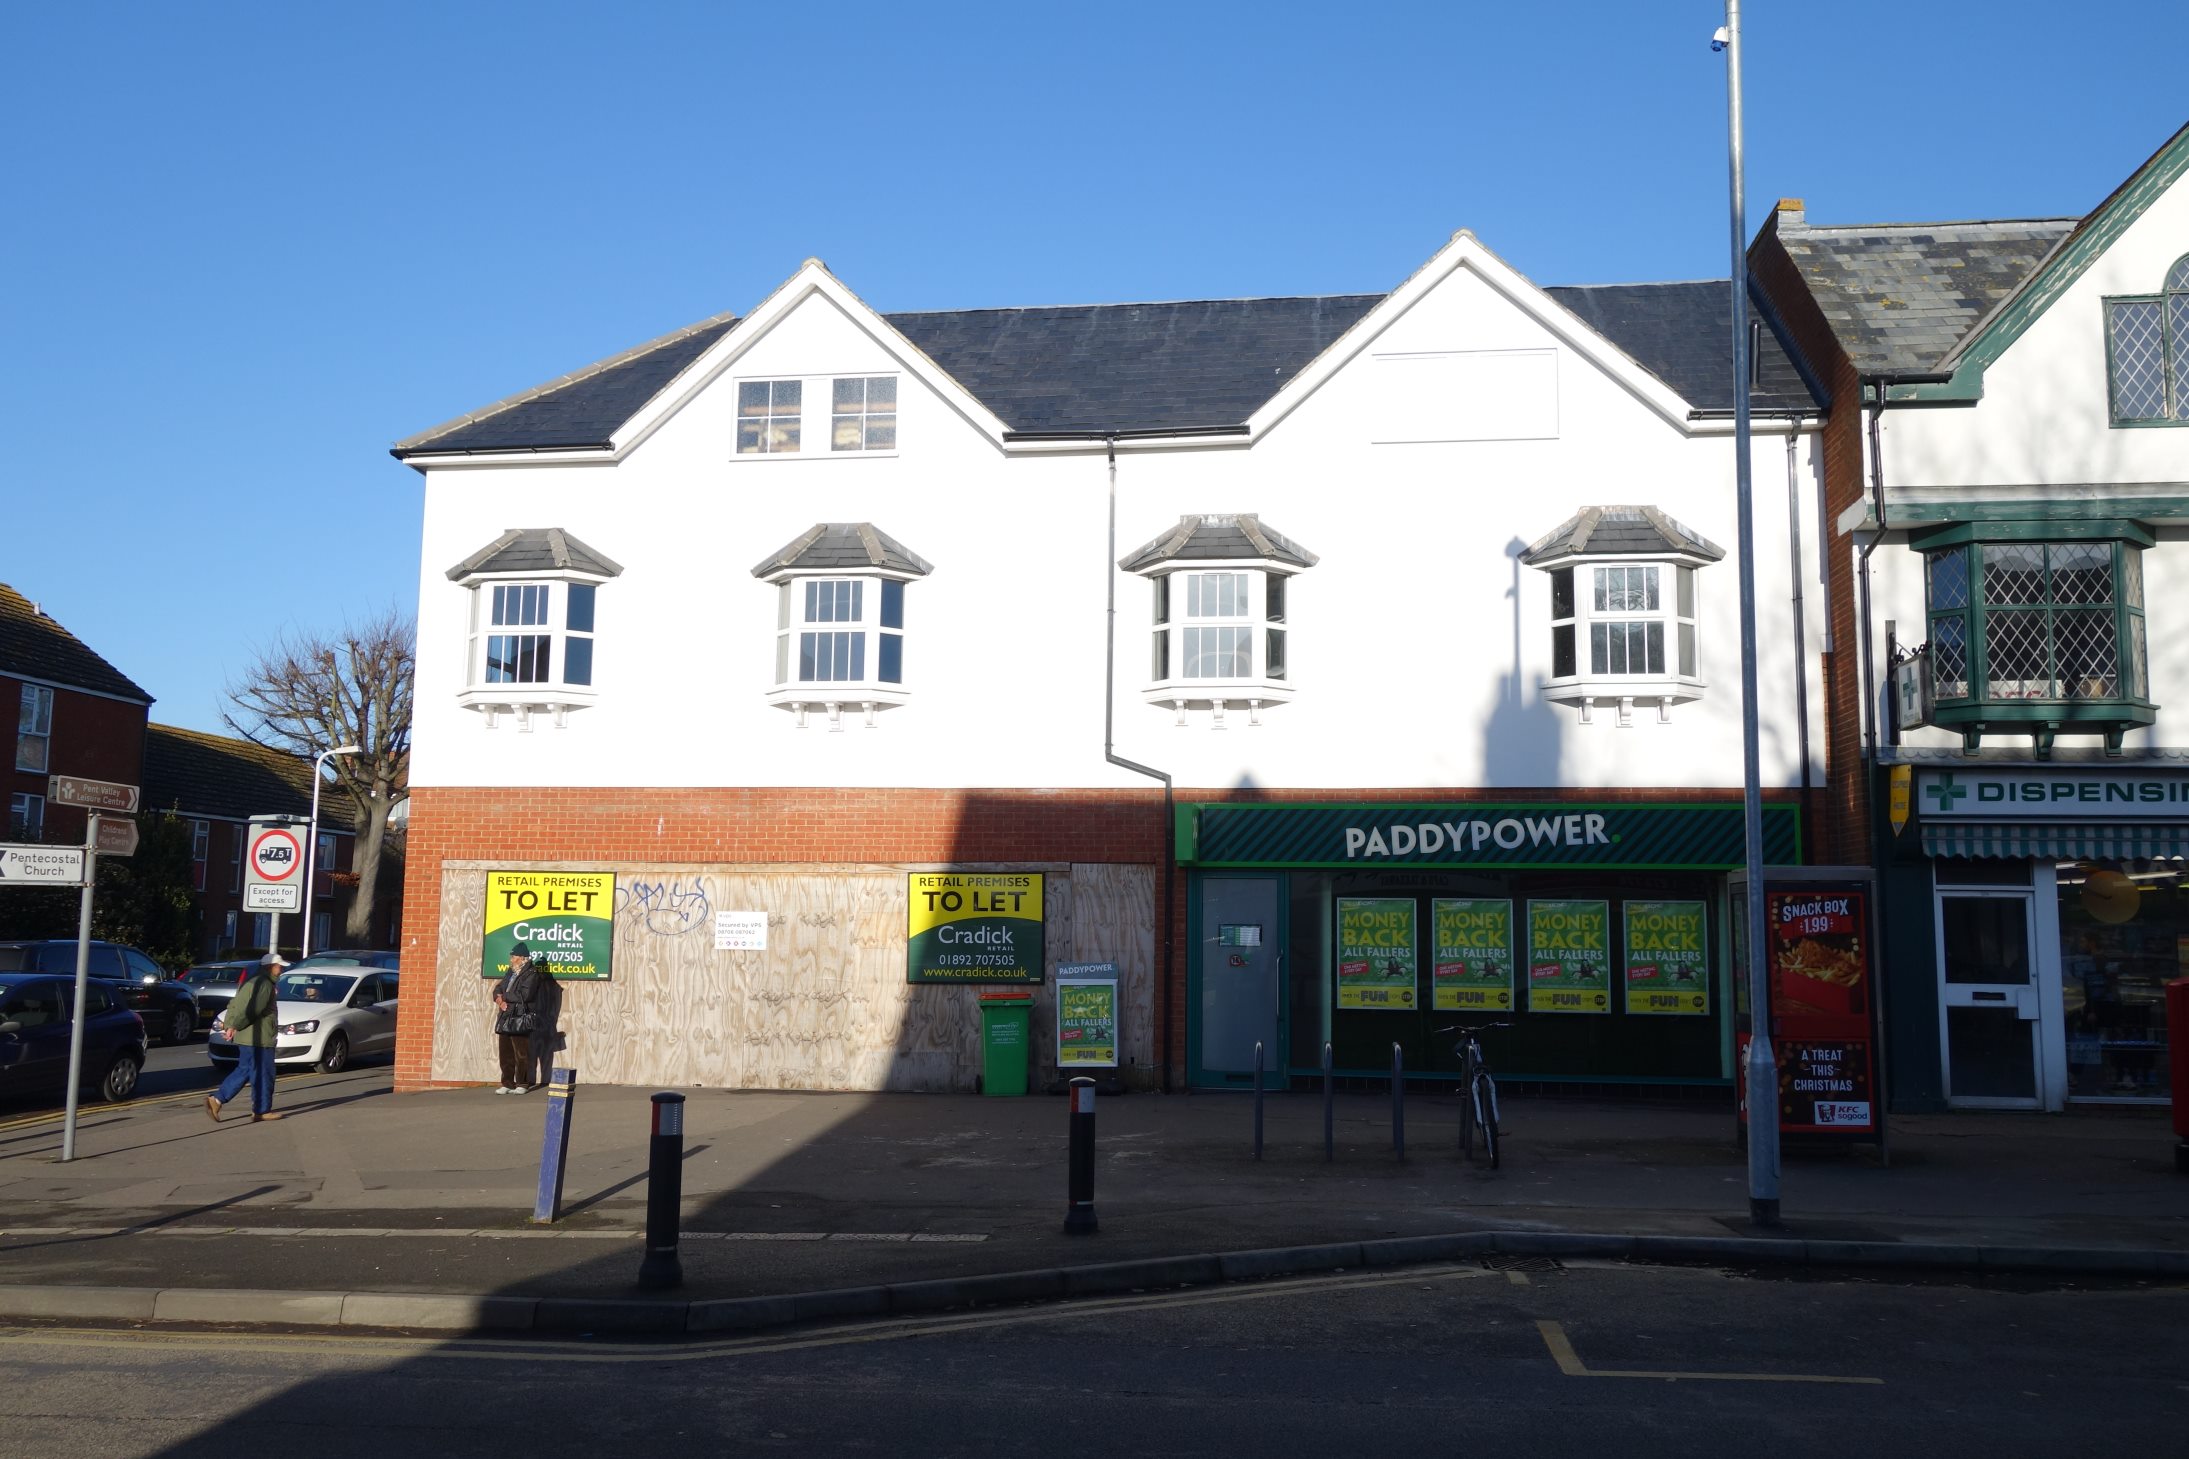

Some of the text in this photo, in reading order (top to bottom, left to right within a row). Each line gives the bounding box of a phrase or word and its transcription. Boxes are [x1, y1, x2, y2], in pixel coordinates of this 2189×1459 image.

[83, 783, 121, 797] Pent Valley
[1977, 782, 2189, 802] DISPENSI
[77, 793, 126, 806] Leisure Centre
[10, 852, 80, 864] Pentecostal
[24, 865, 64, 876] Church
[497, 876, 602, 888] RETAIL PREMISES
[919, 877, 1030, 887] RETAIL PREMISES
[253, 887, 293, 896] Except for
[500, 890, 599, 911] TO LET
[922, 891, 1027, 912] TO LET
[1782, 899, 1849, 922] SNACK BOX
[1344, 911, 1410, 928] MONEY
[1440, 912, 1506, 929] MONEY
[1535, 913, 1602, 930] MONEY
[1631, 914, 1700, 931] MONEY
[1804, 916, 1828, 934] 1.99
[513, 922, 584, 942] Cradick
[938, 925, 1014, 944] Cradick
[1343, 928, 1409, 947] BACK
[1439, 929, 1506, 948] BACK
[1534, 931, 1602, 949] BACK
[1630, 932, 1699, 950] BACK
[546, 951, 583, 962] 707505
[1344, 947, 1411, 957] ALL FALLERS
[1440, 948, 1507, 958] ALL FALLERS
[1535, 950, 1603, 960] ALL FALLERS
[1631, 951, 1701, 961] ALL FALLERS
[939, 955, 1015, 965] 01892 707505
[923, 966, 1027, 978] www.cradick.co.uk
[1059, 964, 1113, 975] PADDYPOWER
[1064, 992, 1112, 1005] MONEY
[1360, 991, 1389, 1002] FUN
[1456, 991, 1485, 1003] FUN
[1552, 993, 1581, 1005] FUN
[1650, 995, 1679, 1007] FUN
[1065, 1005, 1110, 1019] BACK
[1076, 1050, 1097, 1059] FUN
[1801, 1049, 1843, 1061] A TREAT
[1811, 1064, 1834, 1076] THIS
[1794, 1080, 1853, 1092] CHRISTMAS
